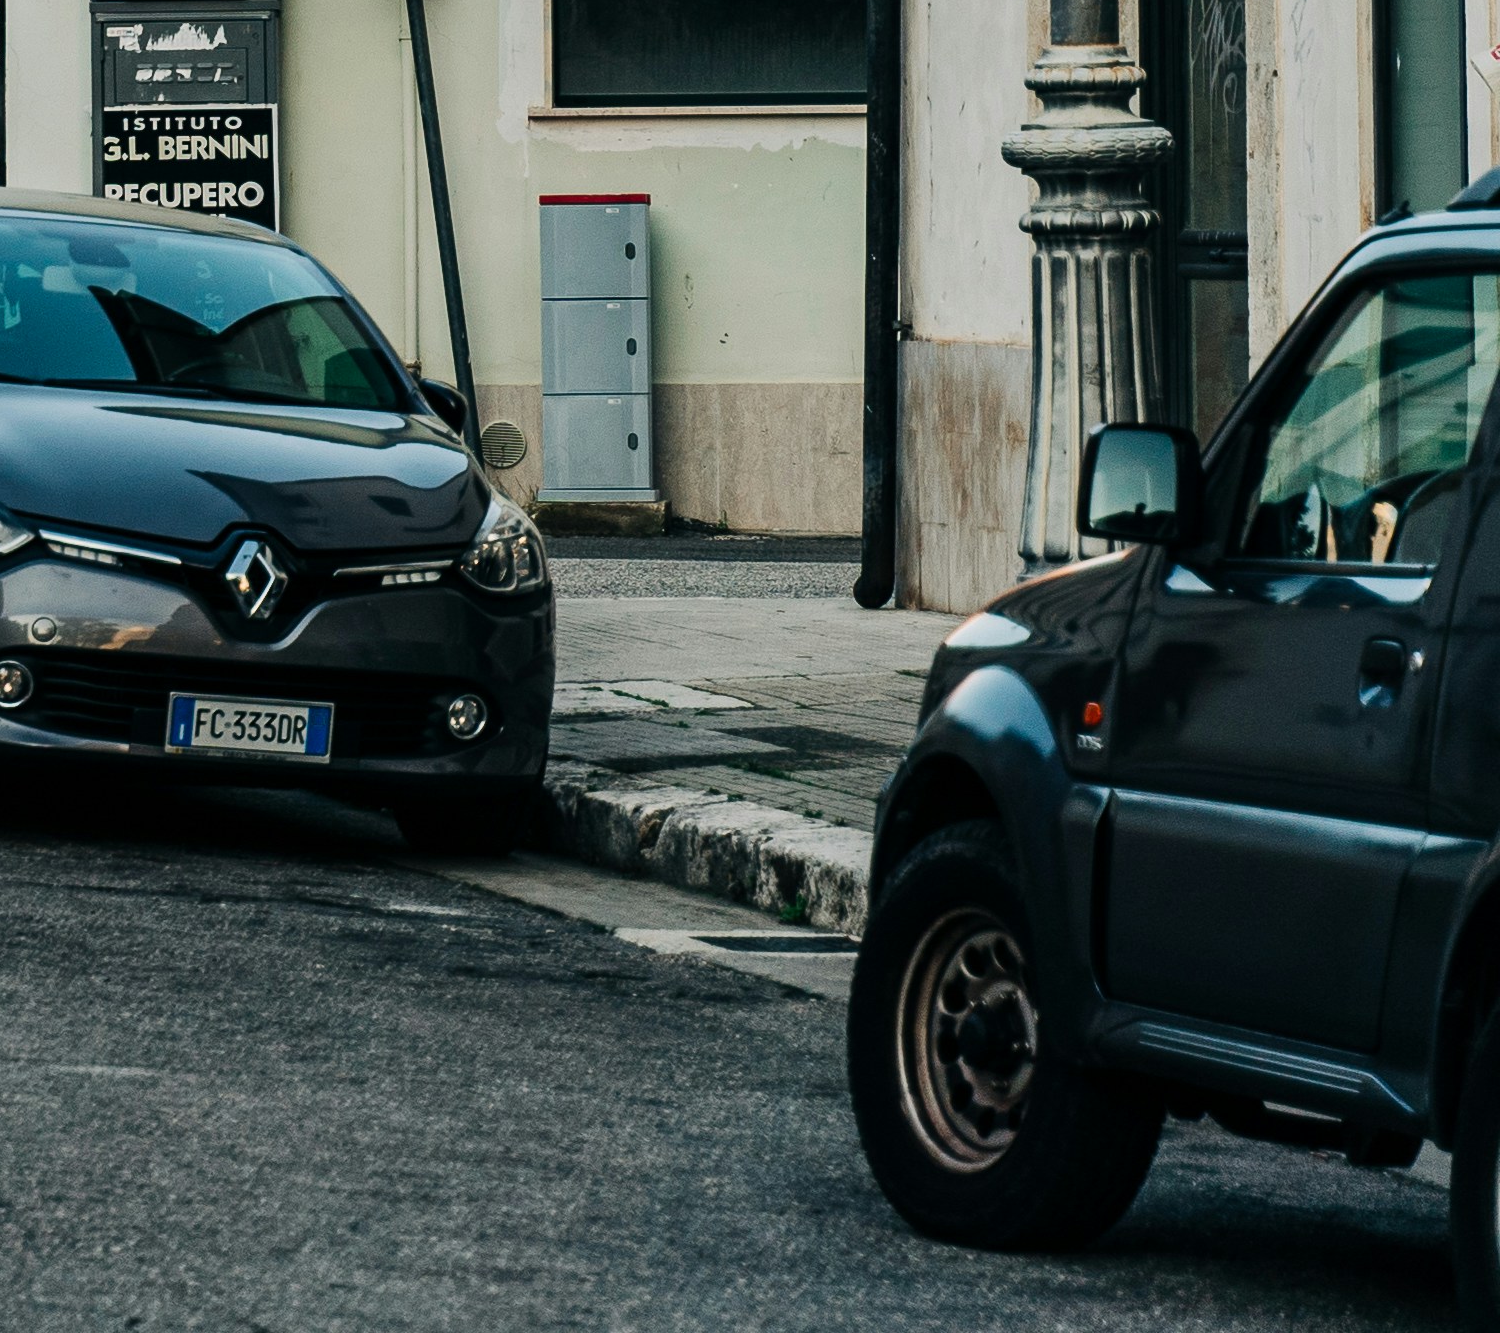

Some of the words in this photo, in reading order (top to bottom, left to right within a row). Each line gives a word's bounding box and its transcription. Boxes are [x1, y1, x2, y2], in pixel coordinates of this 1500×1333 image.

[122, 116, 243, 131] ISTITUTO
[103, 135, 150, 162] G.L.
[158, 133, 269, 160] BERNINI
[104, 181, 265, 208] RECUPERO
